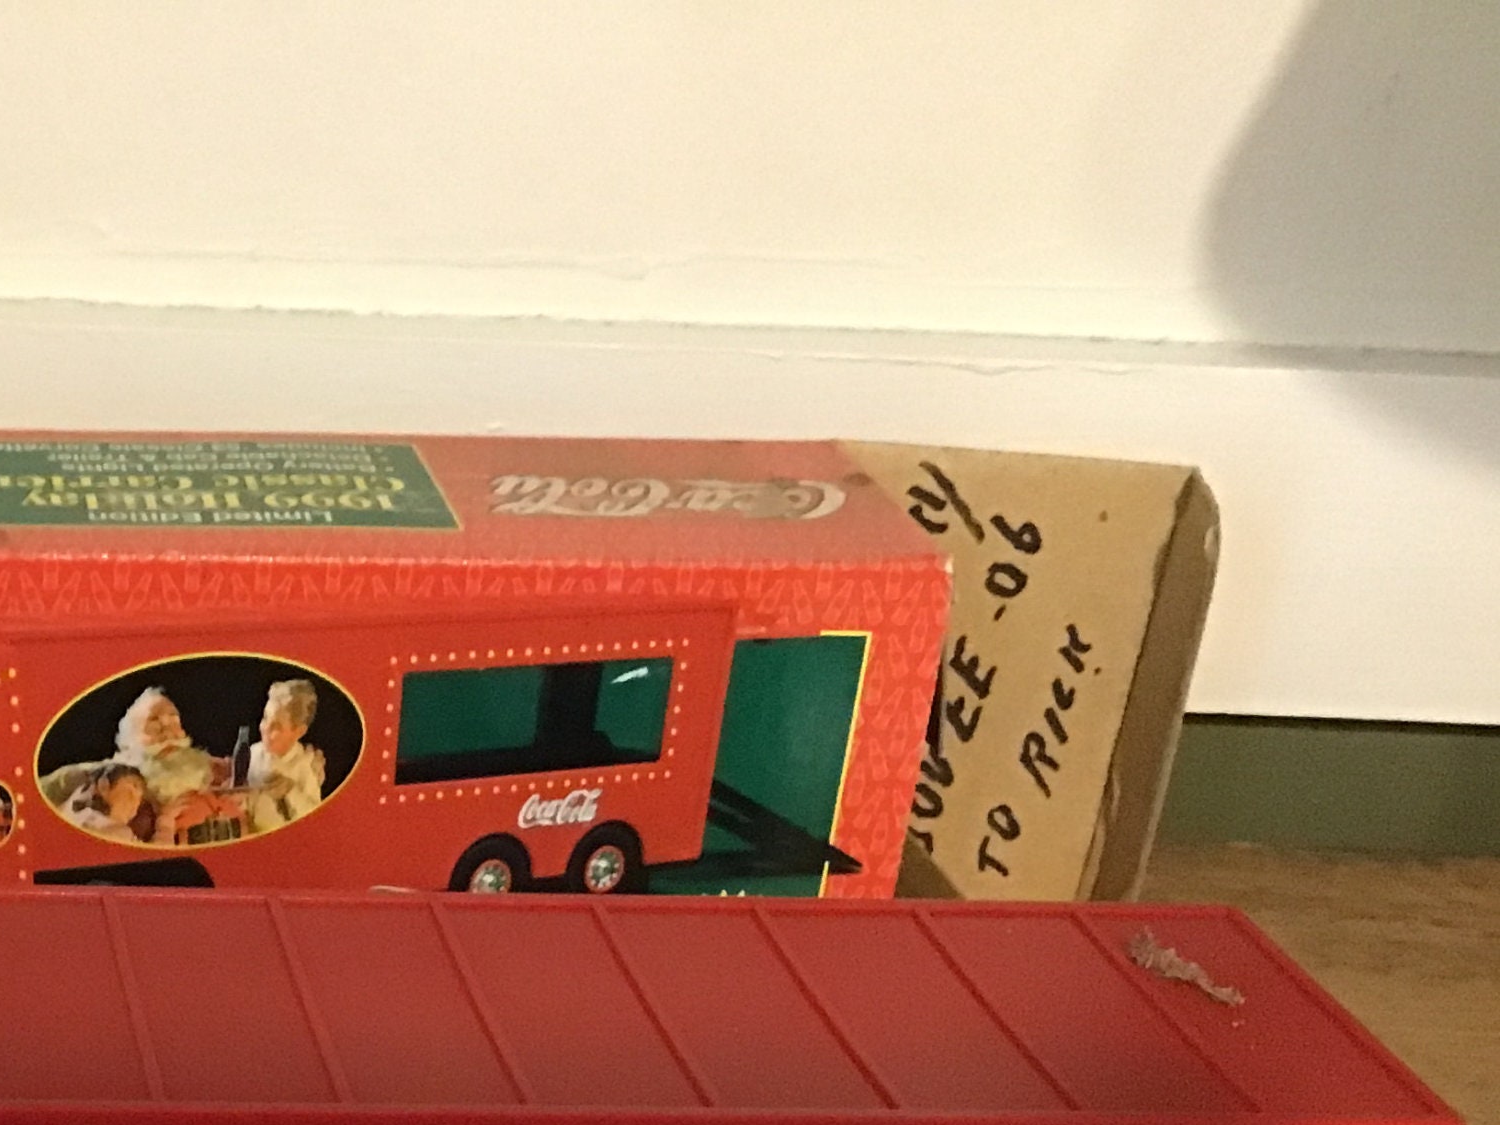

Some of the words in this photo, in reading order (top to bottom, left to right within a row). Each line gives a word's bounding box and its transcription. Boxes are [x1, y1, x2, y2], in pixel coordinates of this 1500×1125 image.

[213, 474, 405, 492] Classic
[21, 489, 241, 511] Holiday
[263, 492, 395, 511] 1999
[87, 511, 203, 523] Edition
[211, 510, 333, 523] Limited
[517, 788, 603, 829] Coca-Cola
[977, 804, 1022, 877] TO
